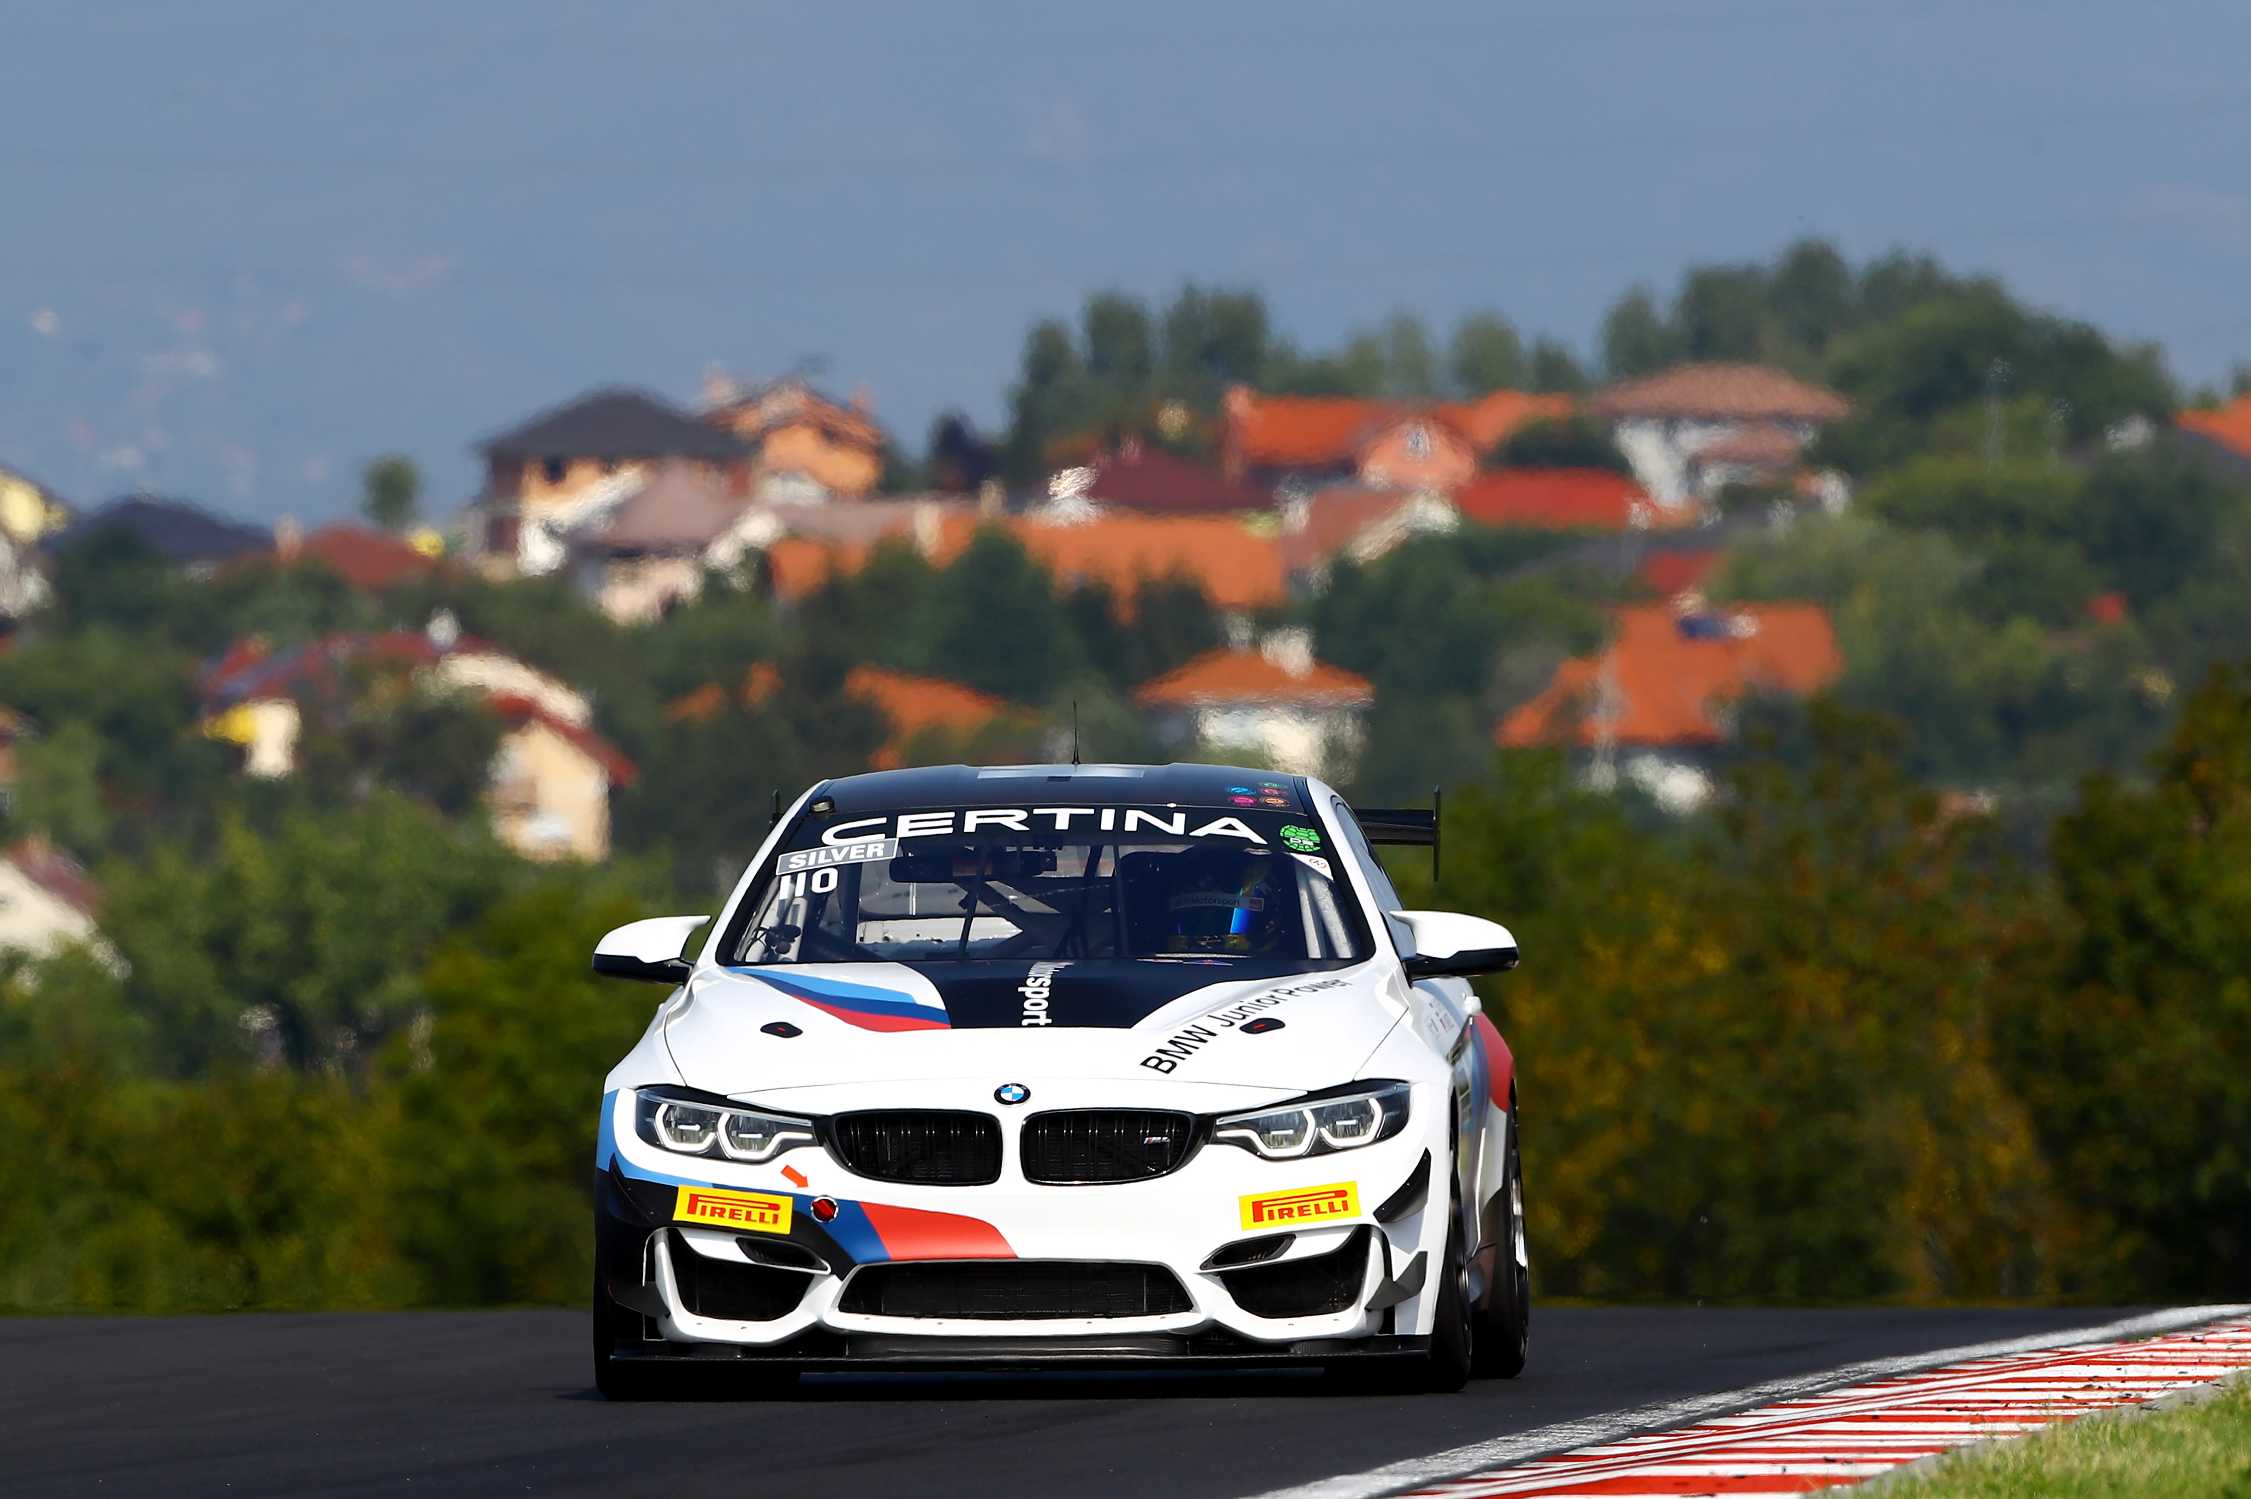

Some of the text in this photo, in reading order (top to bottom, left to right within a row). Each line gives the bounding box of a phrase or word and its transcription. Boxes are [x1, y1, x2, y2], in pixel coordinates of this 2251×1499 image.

[821, 808, 1268, 846] CERTINA
[788, 843, 885, 869] SILVER
[779, 867, 839, 899] 110
[1140, 978, 1353, 1074] BMW Junior Power
[687, 1193, 780, 1224] PIRELLI
[1252, 1190, 1348, 1222] PIRELLI
